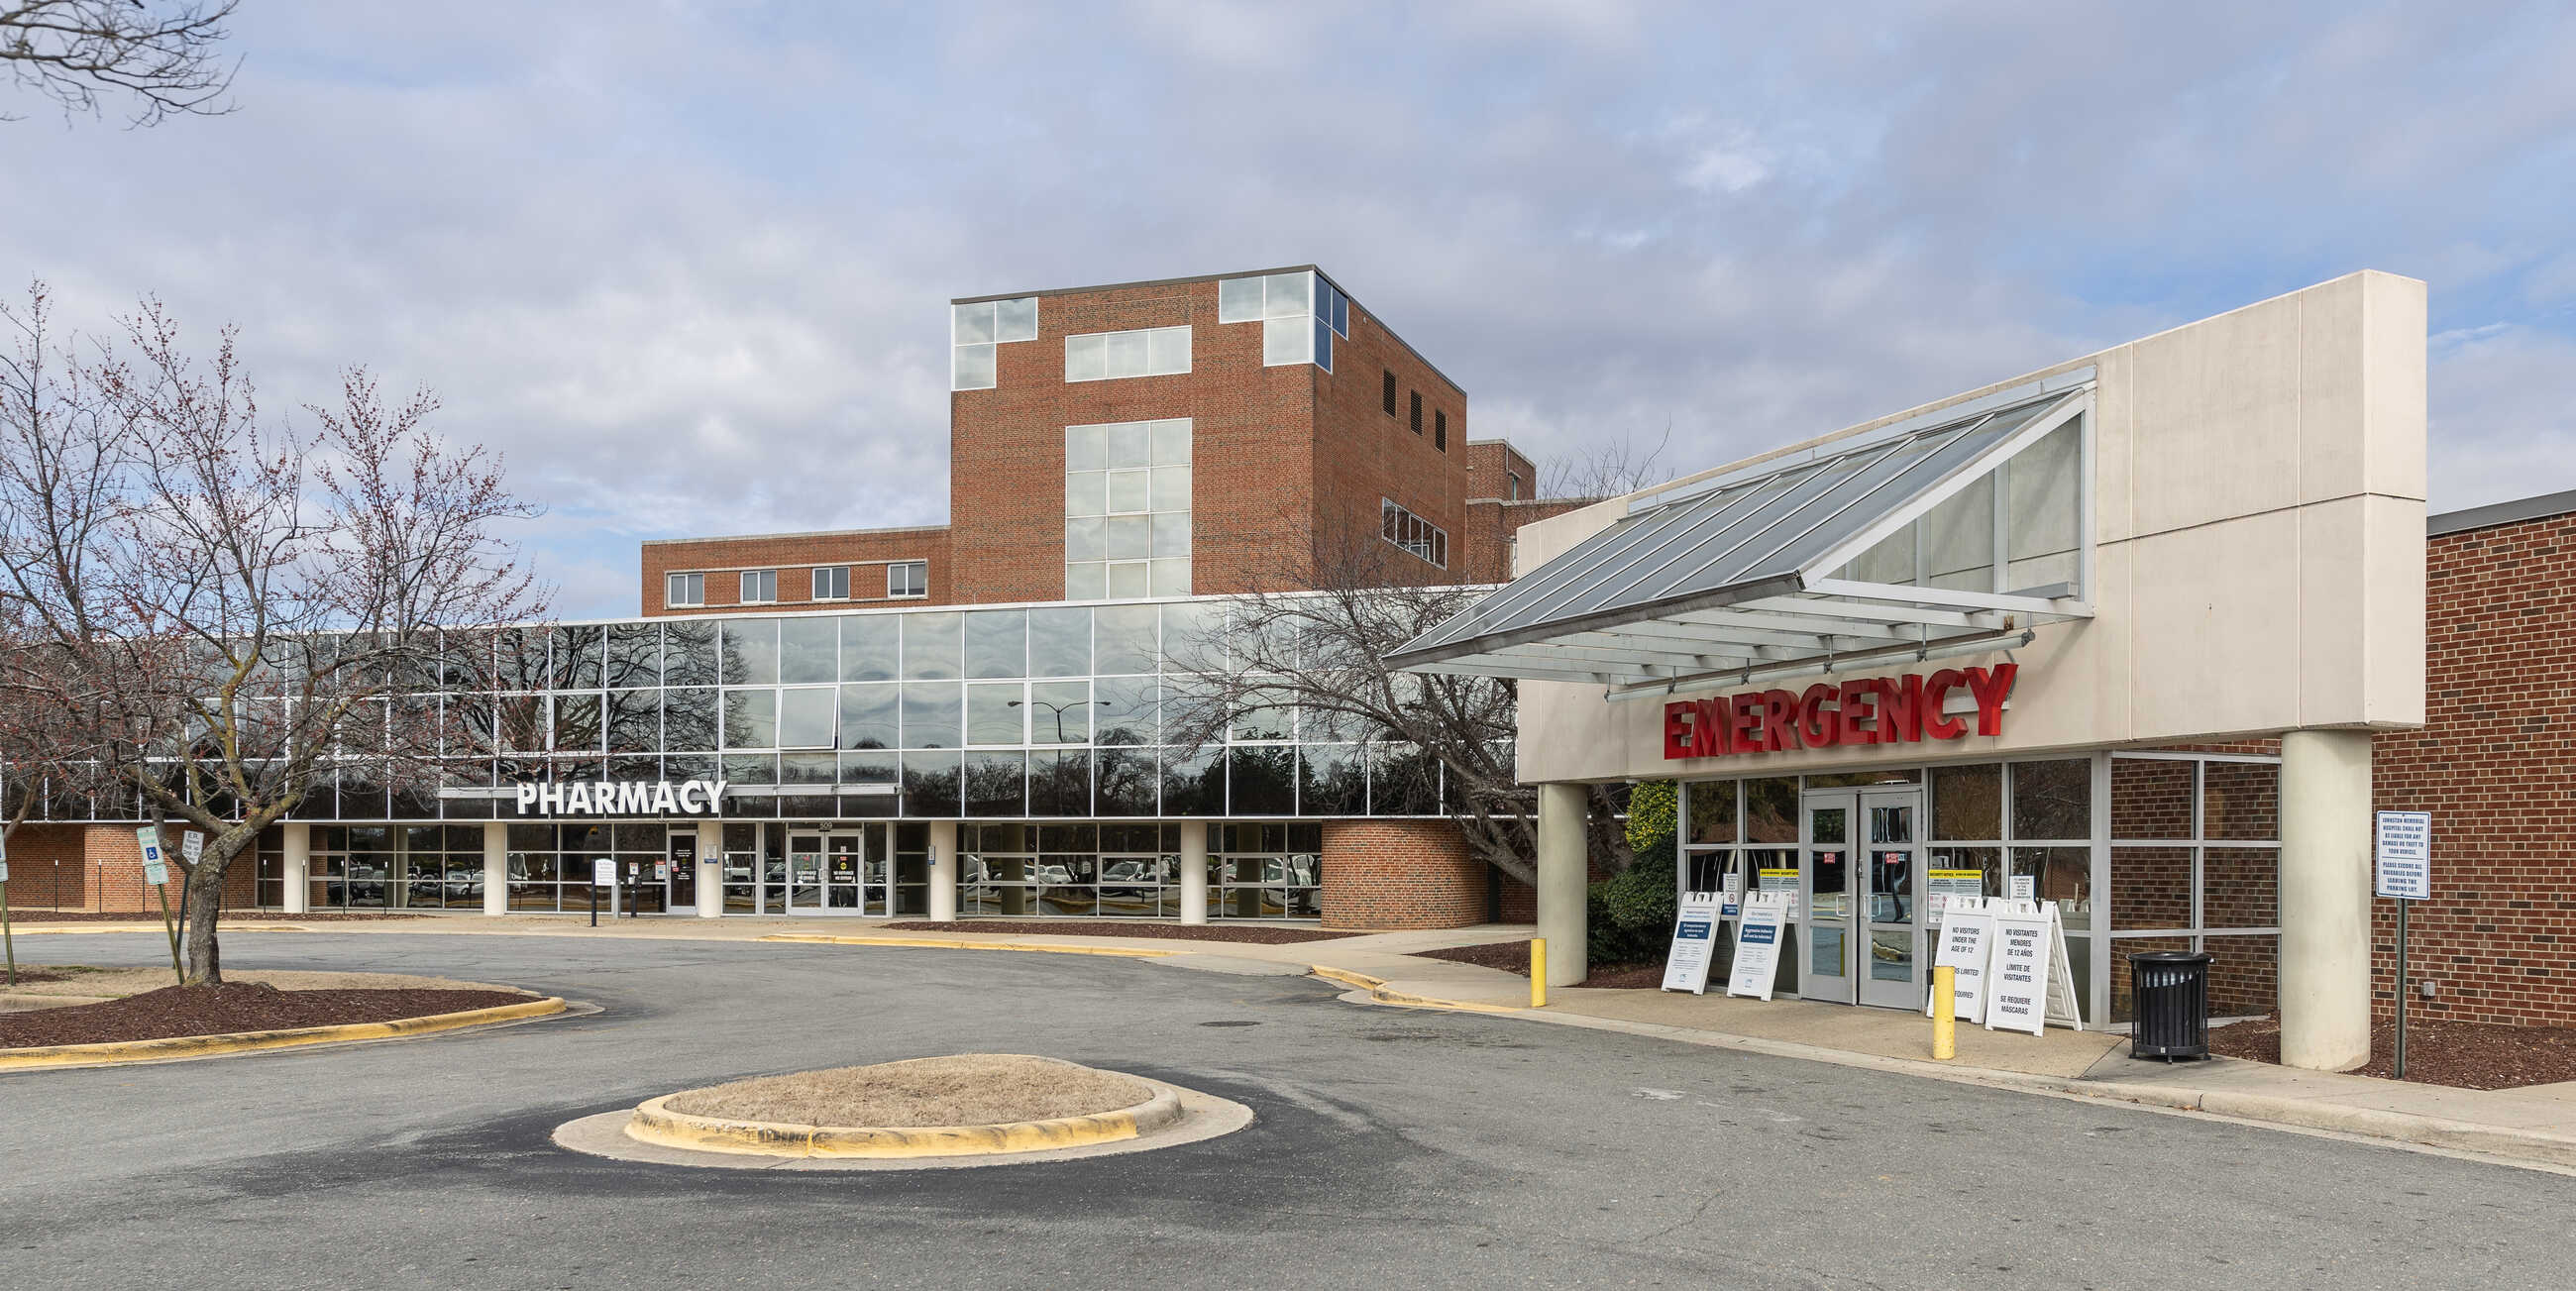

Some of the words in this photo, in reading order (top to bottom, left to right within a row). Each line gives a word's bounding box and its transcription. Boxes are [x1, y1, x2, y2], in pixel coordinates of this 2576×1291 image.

[1664, 664, 2018, 760] EMERGENCY
[517, 781, 726, 814] PHARMACY
[2009, 938, 2032, 947] MENORES
[2003, 973, 2032, 983] VISITANTES
[1954, 990, 1974, 999] EQUIRED
[2007, 996, 2031, 1006] REQUIERE
